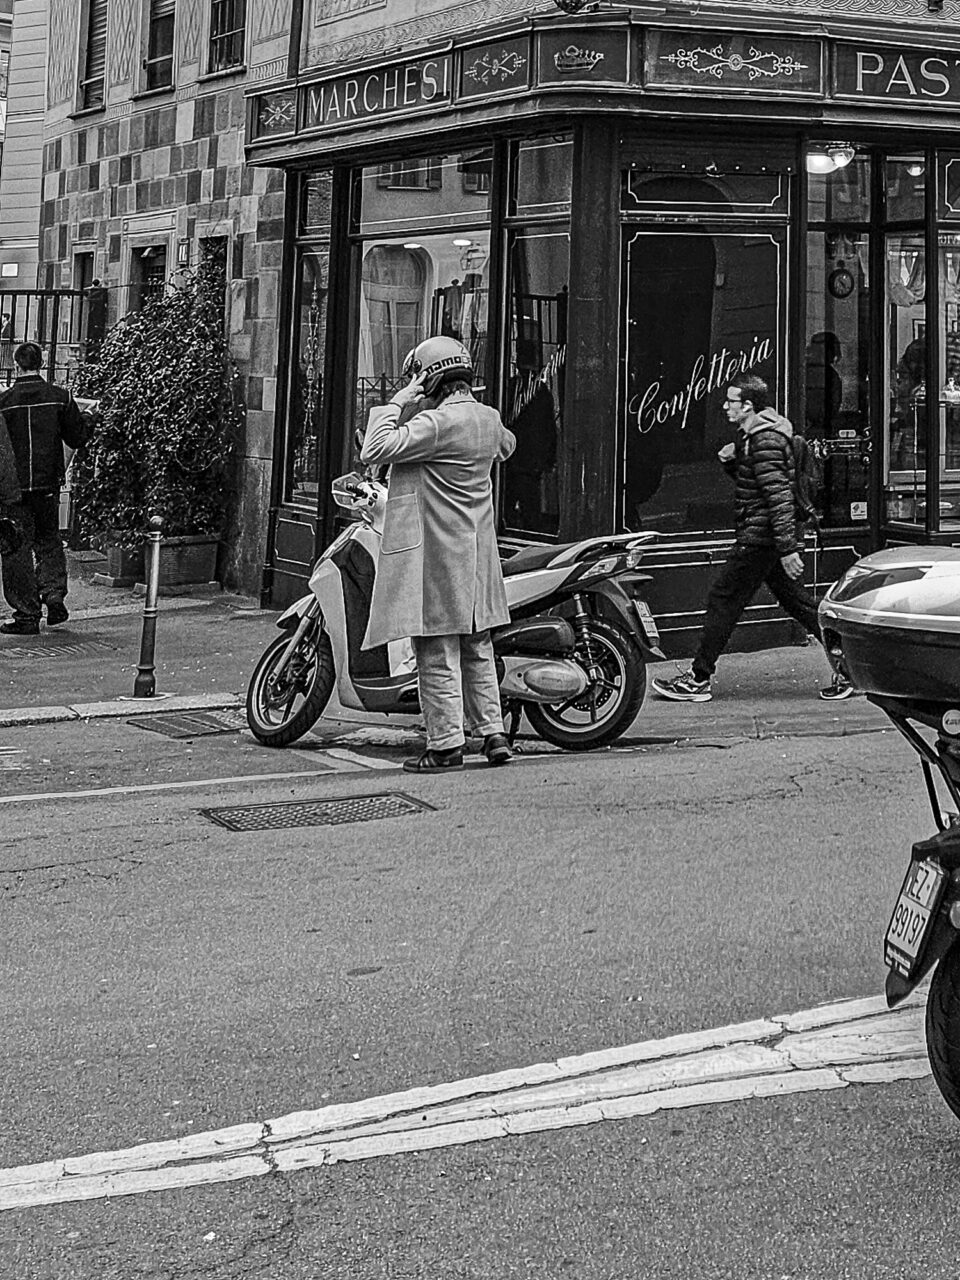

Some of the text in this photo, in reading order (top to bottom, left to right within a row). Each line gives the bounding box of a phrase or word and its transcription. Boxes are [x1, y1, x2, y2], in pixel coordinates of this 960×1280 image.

[309, 60, 450, 124] MARCHESI
[629, 336, 773, 433] Confetteria
[910, 865, 929, 900] EZ
[892, 903, 926, 948] 99197
